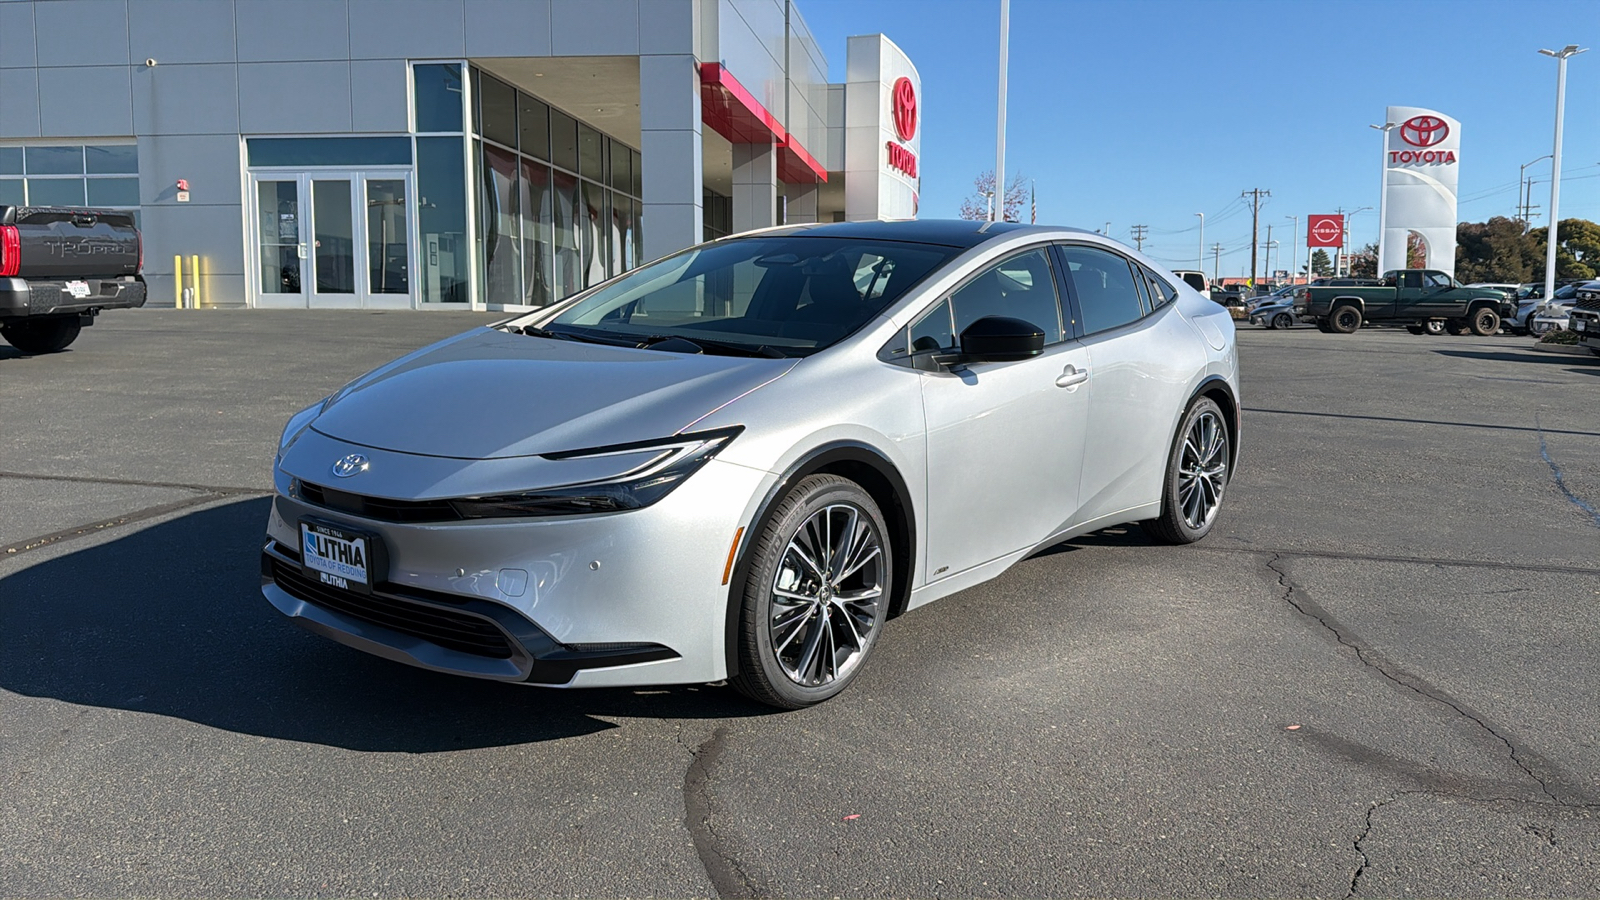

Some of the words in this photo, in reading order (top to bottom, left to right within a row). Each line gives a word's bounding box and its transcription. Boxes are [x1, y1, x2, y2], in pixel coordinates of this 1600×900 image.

[887, 141, 916, 178] TOYOTA
[1389, 151, 1456, 163] TOYOTA
[316, 526, 331, 535] SINCE
[331, 529, 343, 538] 1946
[316, 535, 365, 569] LITHIA
[306, 553, 328, 569] TOYOTA
[328, 561, 336, 571] OF
[337, 563, 367, 579] REDDING
[327, 574, 349, 590] LITHIA
